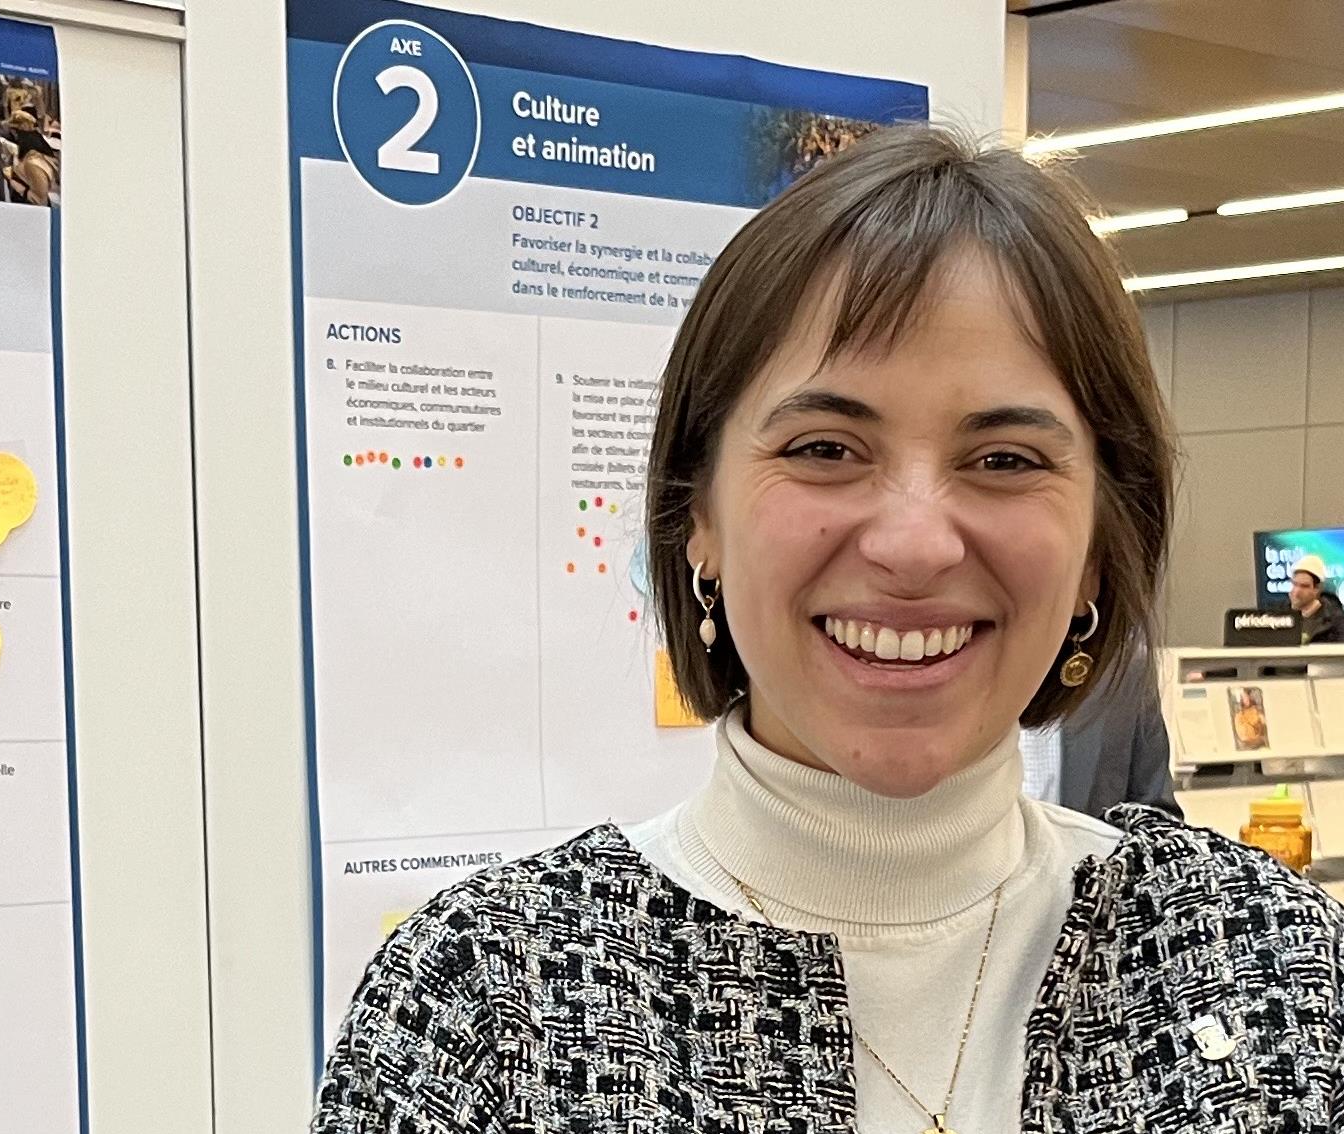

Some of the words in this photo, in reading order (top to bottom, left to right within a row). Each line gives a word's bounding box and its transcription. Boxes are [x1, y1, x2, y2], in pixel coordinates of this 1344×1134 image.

[390, 37, 422, 56] AXE
[374, 64, 441, 175] 2
[512, 91, 599, 127] Culture
[512, 133, 536, 158] et
[542, 136, 655, 172] animation
[512, 205, 585, 227] OBJECTIF
[590, 213, 598, 229] 2
[512, 233, 572, 252] Favoriser
[575, 240, 587, 254] la
[590, 245, 643, 262] synergie
[646, 249, 659, 261] et
[662, 249, 672, 262] la
[512, 258, 565, 276] culturel,
[568, 262, 645, 283] économique
[648, 272, 660, 284] et
[326, 323, 401, 344] ACTIONS
[1234, 613, 1294, 631] périodiques
[344, 859, 397, 874] AUTRES
[400, 852, 503, 871] COMMENTAIRES
